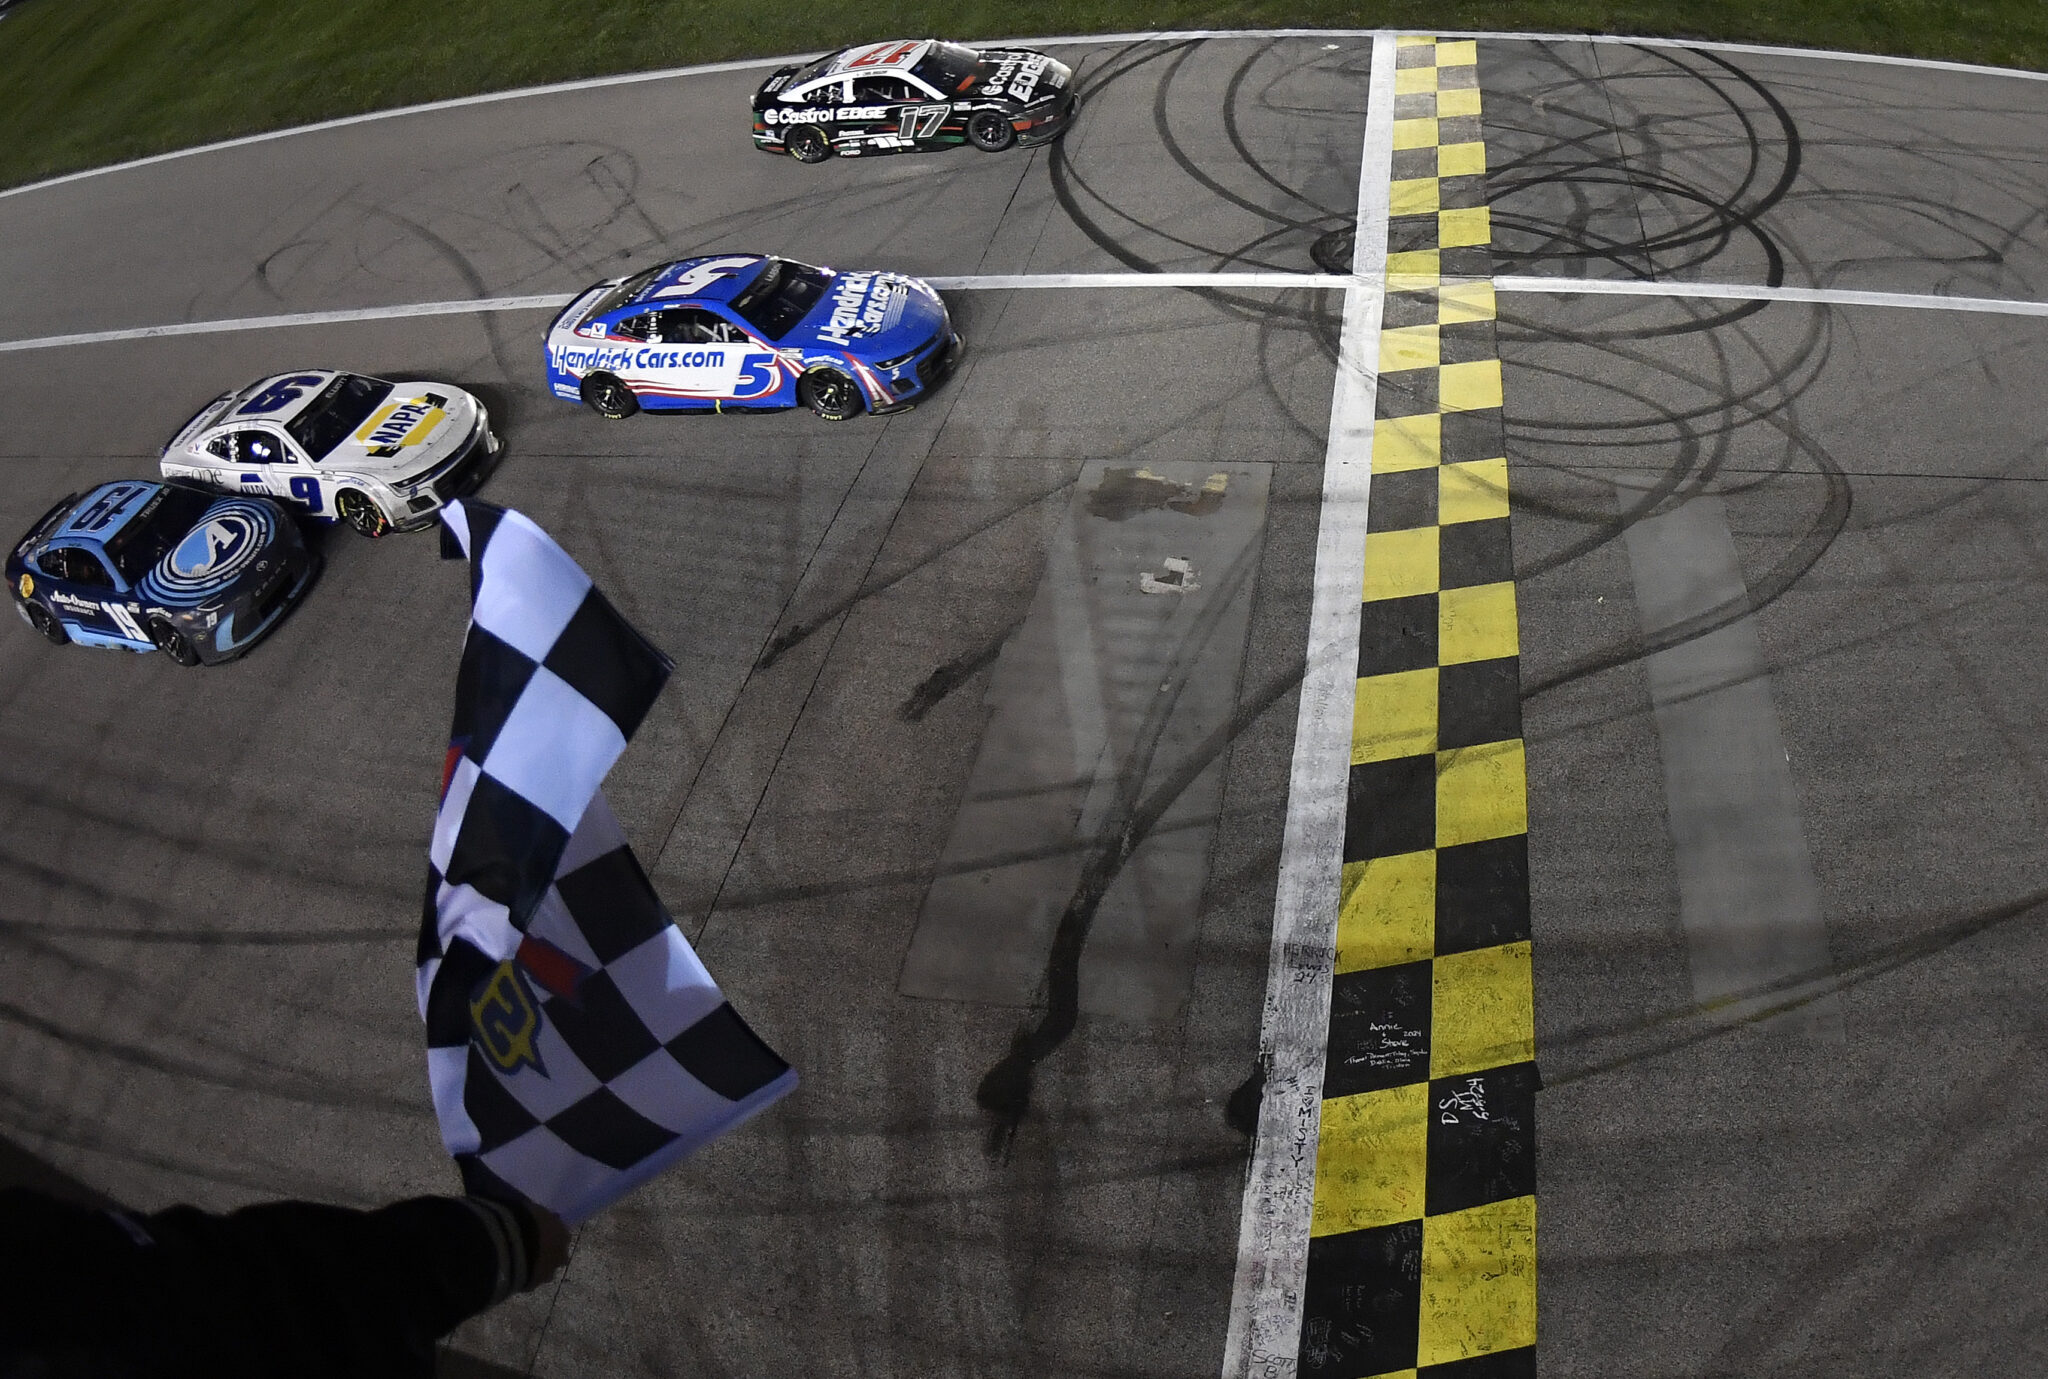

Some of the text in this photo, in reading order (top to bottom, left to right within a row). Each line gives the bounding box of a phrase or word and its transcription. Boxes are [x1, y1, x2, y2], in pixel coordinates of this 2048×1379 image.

[779, 105, 887, 123] Castrol EDGE
[899, 104, 951, 139] 17
[653, 256, 761, 298] 5
[817, 271, 872, 347] Hendrick
[325, 376, 348, 399] ELLIOTT
[733, 353, 779, 397] 5
[892, 368, 900, 381] 5
[235, 374, 326, 416] 9
[368, 399, 431, 444] NAPA
[67, 484, 150, 533] 19
[289, 476, 323, 514] 9
[409, 486, 418, 498] 9
[100, 601, 151, 643] 19
[205, 612, 217, 628] 19
